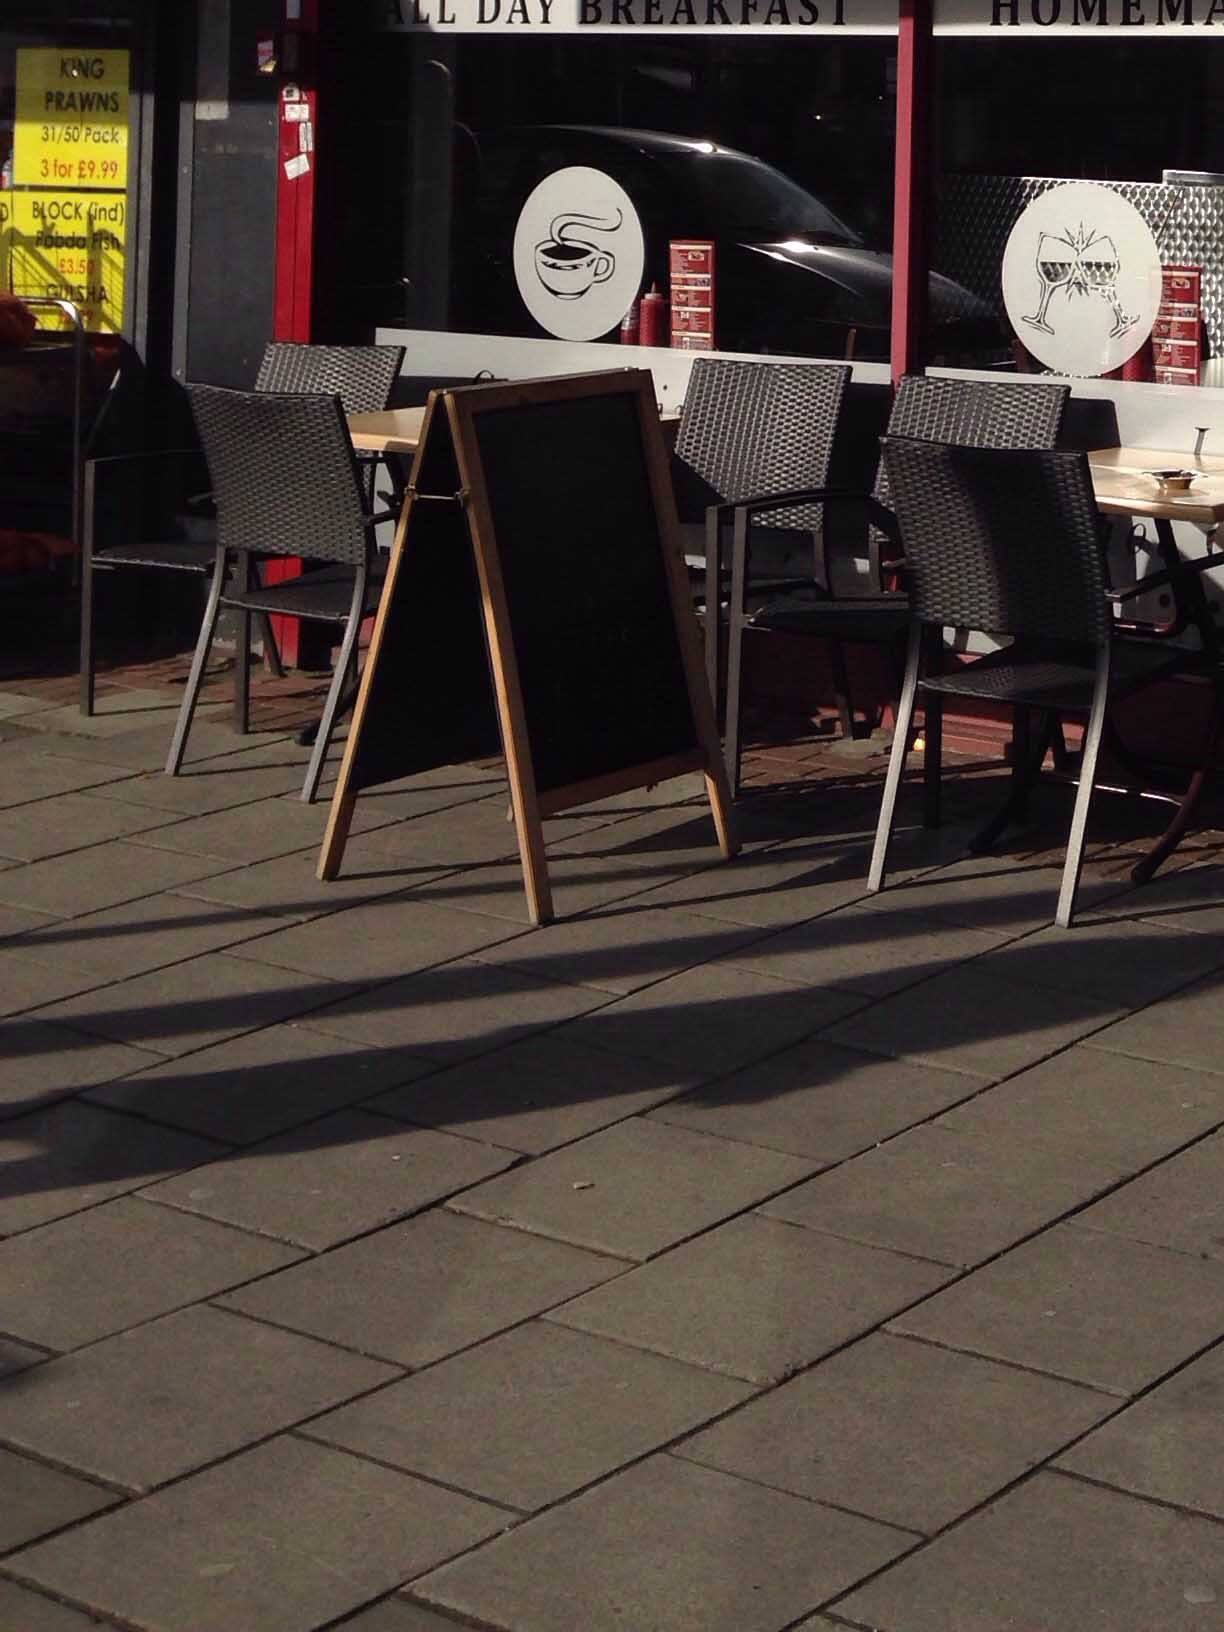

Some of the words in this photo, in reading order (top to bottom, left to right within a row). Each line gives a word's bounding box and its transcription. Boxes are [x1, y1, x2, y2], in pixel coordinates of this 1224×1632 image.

[59, 57, 105, 80] KING
[45, 91, 120, 113] PRAWNS
[41, 126, 80, 144] 31/50
[84, 125, 120, 144] Pack
[41, 159, 49, 178] 3
[53, 159, 73, 178] for
[78, 159, 119, 180] £9.99
[32, 201, 83, 221] BLOCK
[88, 201, 124, 226] (ind)
